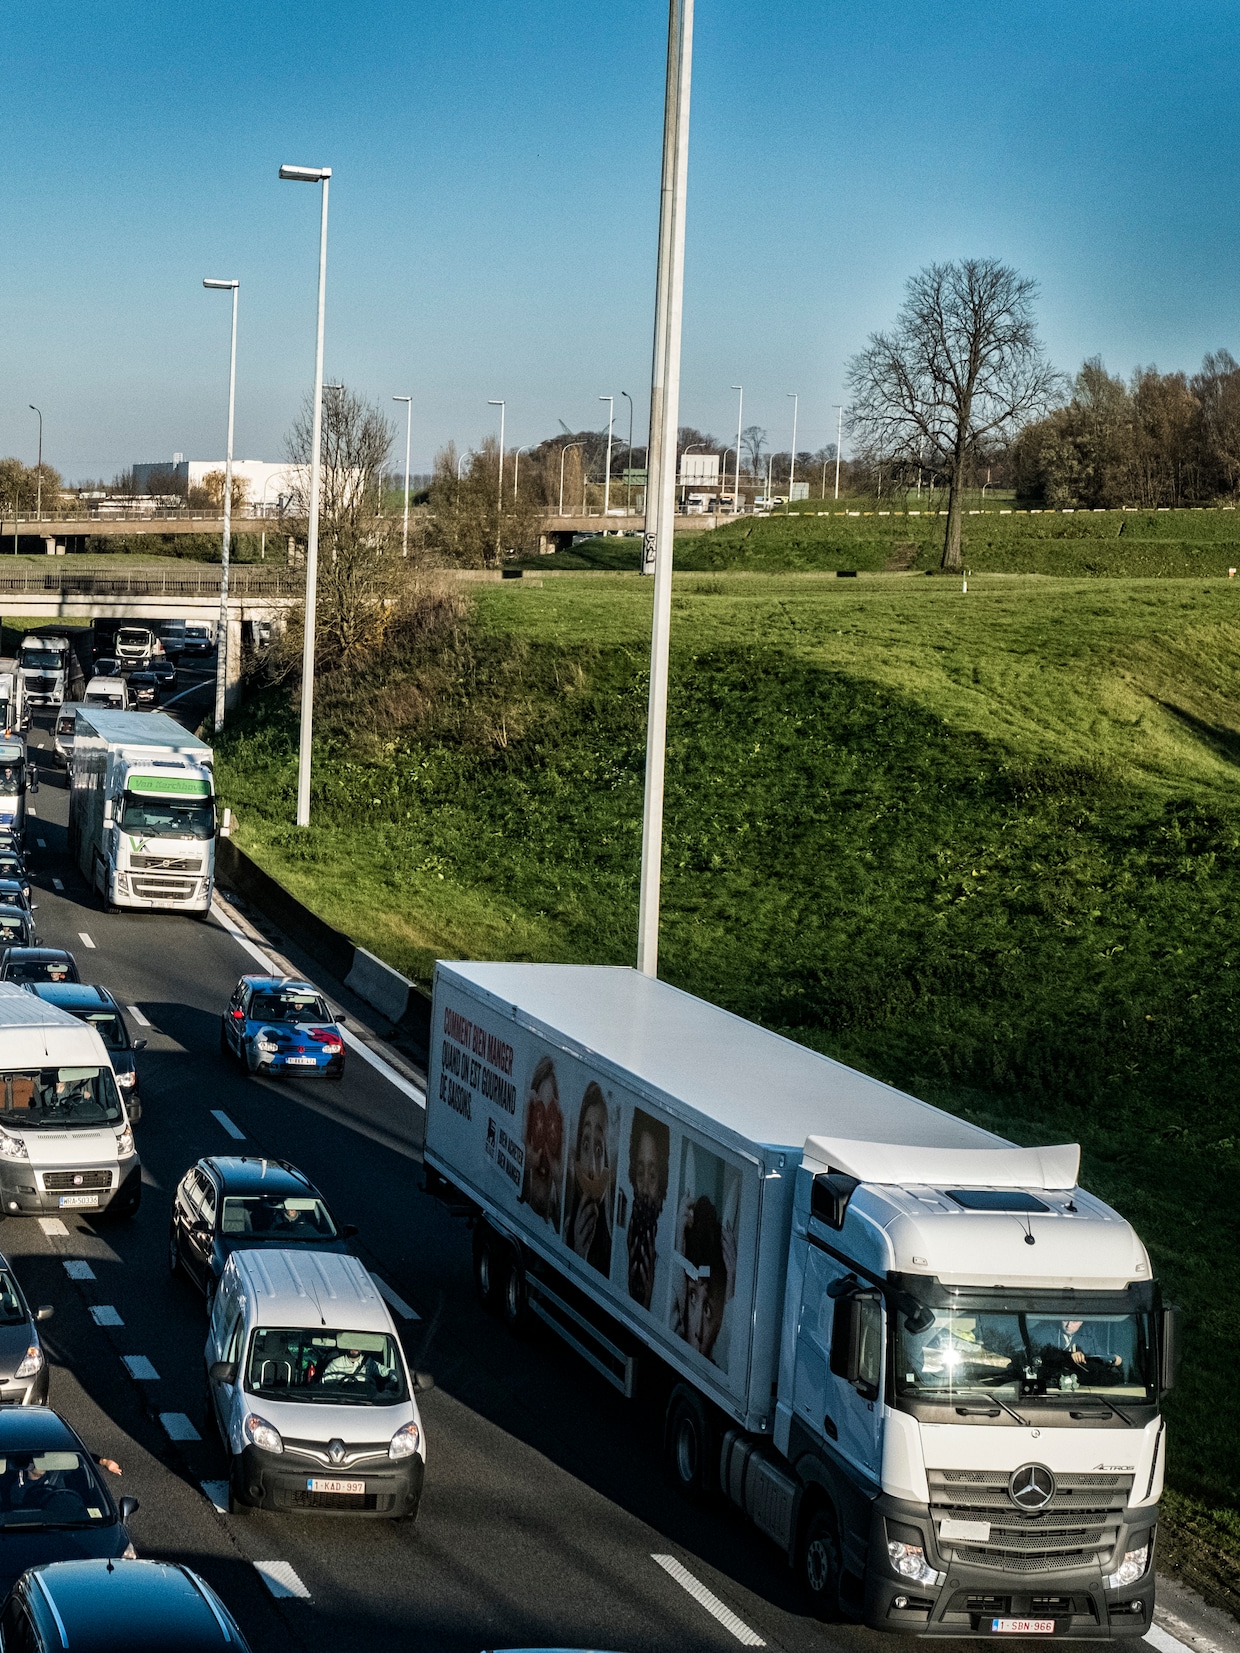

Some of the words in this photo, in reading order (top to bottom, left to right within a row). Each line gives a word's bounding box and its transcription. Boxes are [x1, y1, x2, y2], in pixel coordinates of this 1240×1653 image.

[135, 780, 153, 788] Van
[443, 1006, 473, 1050] COMMENT
[471, 1024, 487, 1060] BIEN
[486, 1033, 514, 1078] MANGER
[439, 1071, 448, 1103] DE
[441, 1039, 461, 1078] QUAND
[460, 1052, 470, 1084] ON
[469, 1058, 482, 1091] EST
[481, 1066, 517, 1116] GOURMAND
[1000, 1621, 1052, 1631] 1-SBN-966
